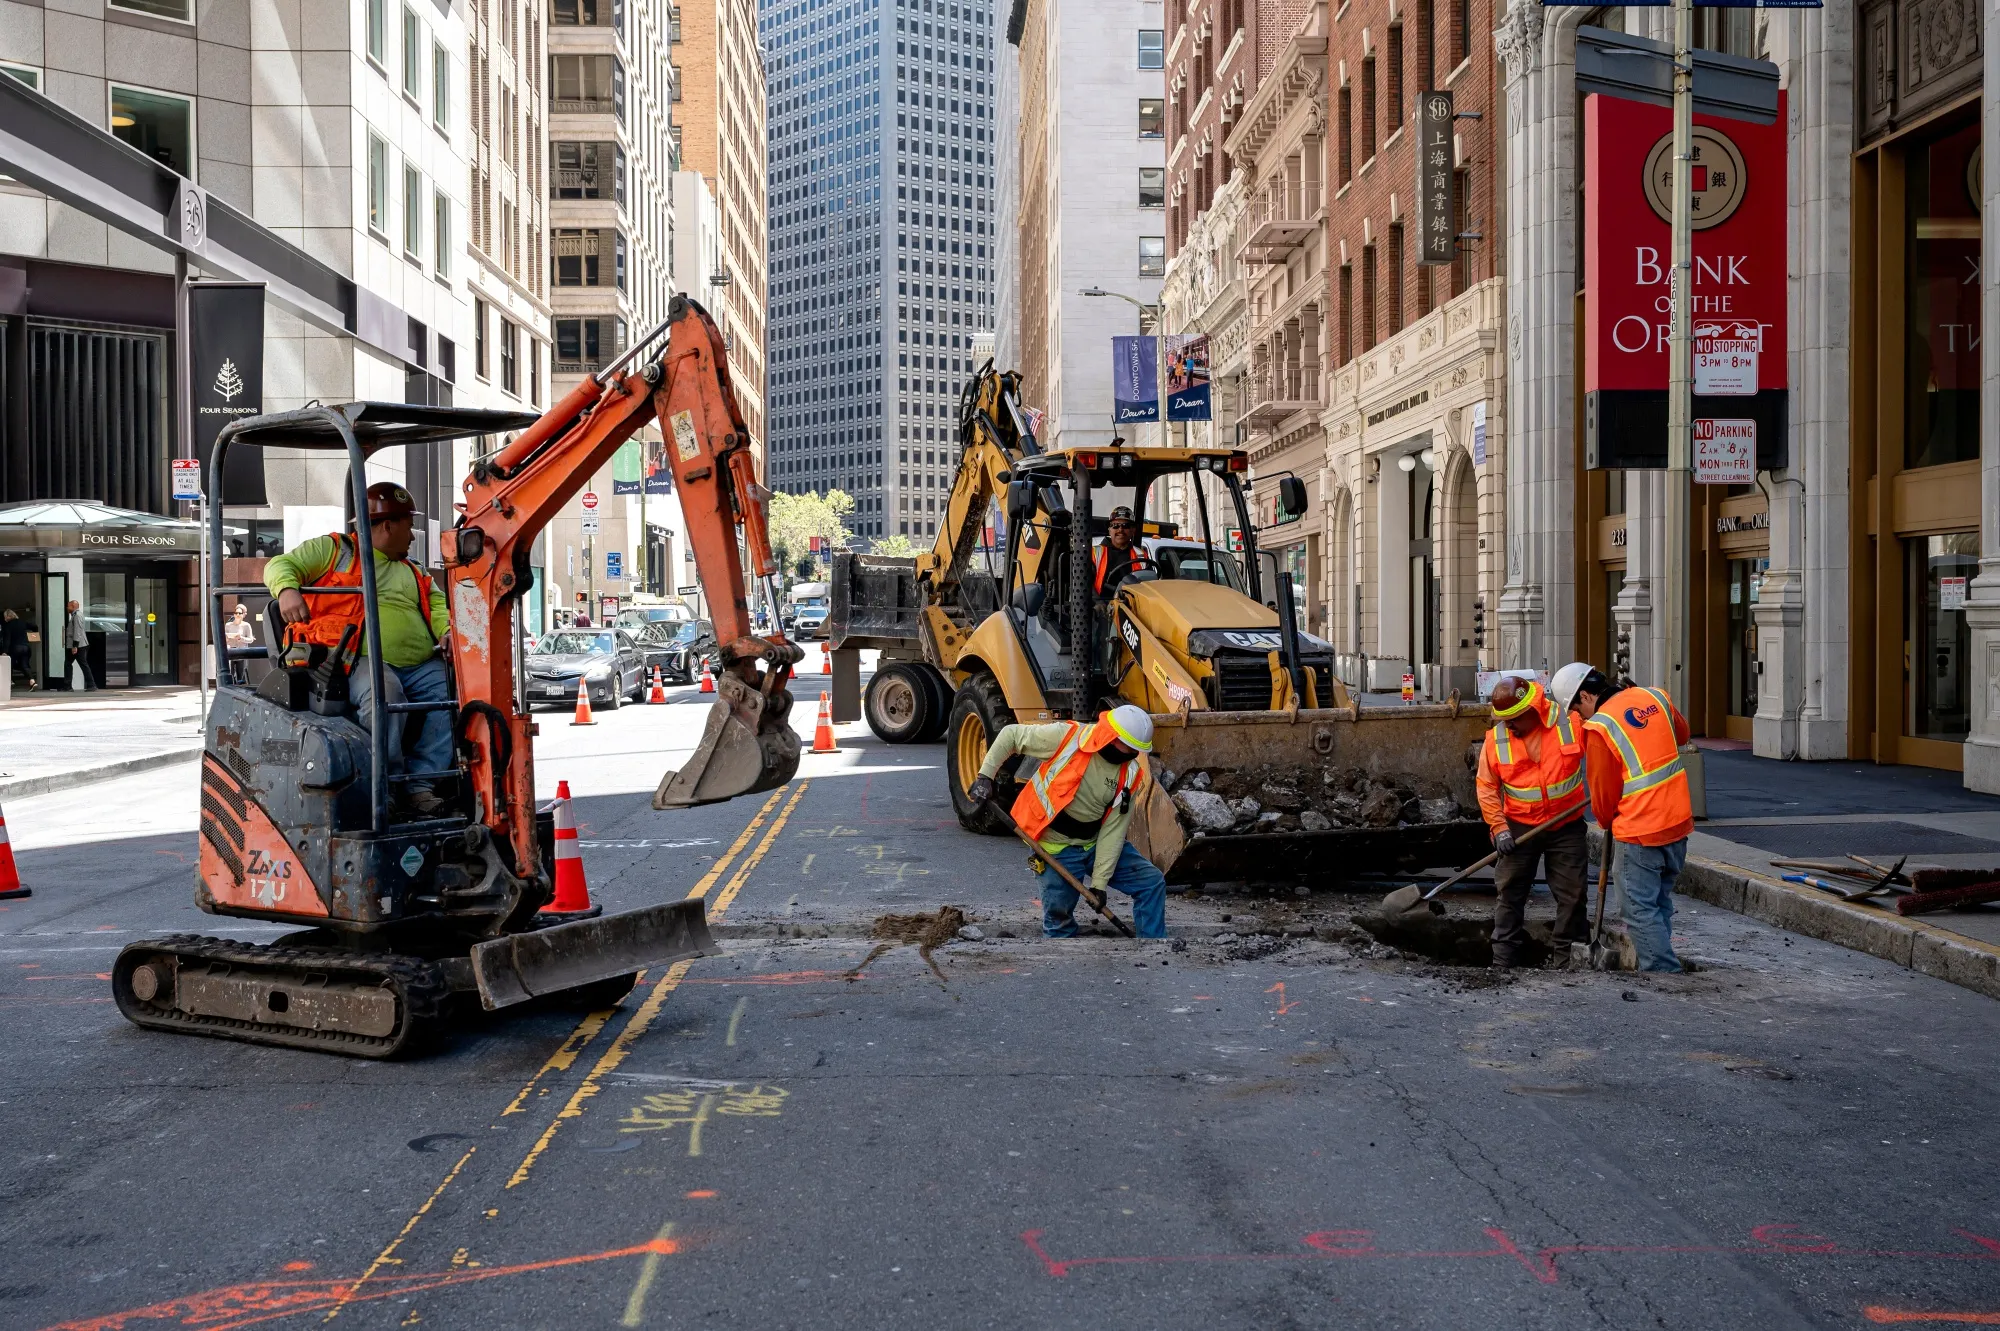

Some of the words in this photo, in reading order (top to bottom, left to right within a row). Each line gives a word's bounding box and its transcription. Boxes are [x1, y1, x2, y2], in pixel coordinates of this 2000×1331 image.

[1430, 131, 1448, 252] 上海商業銀行
[1635, 246, 1750, 284] BNK
[1691, 296, 1732, 312] THE
[1612, 316, 1772, 352] ORT
[1696, 338, 1711, 352] NO
[1714, 340, 1756, 352] STOPPING
[1700, 355, 1707, 367] 3
[1710, 358, 1720, 367] PM
[1732, 356, 1738, 368] 8
[1740, 358, 1752, 367] PM
[1132, 353, 1140, 400] DOWNTOWN
[1174, 398, 1204, 409] Dream
[1120, 408, 1146, 419] Down
[1696, 422, 1712, 438] NO
[1715, 426, 1752, 438] PARKING
[1700, 442, 1706, 454] 2
[1730, 442, 1736, 454] 6
[1700, 460, 1720, 469] MON
[1734, 460, 1748, 469] FRI
[1717, 516, 1737, 533] BANK
[82, 534, 118, 544] FOUR
[122, 535, 176, 546] SEASONS
[1122, 620, 1139, 650] 420F
[1224, 633, 1282, 648] CAT
[1637, 704, 1658, 718] JMB
[247, 850, 291, 879] ZAXIS
